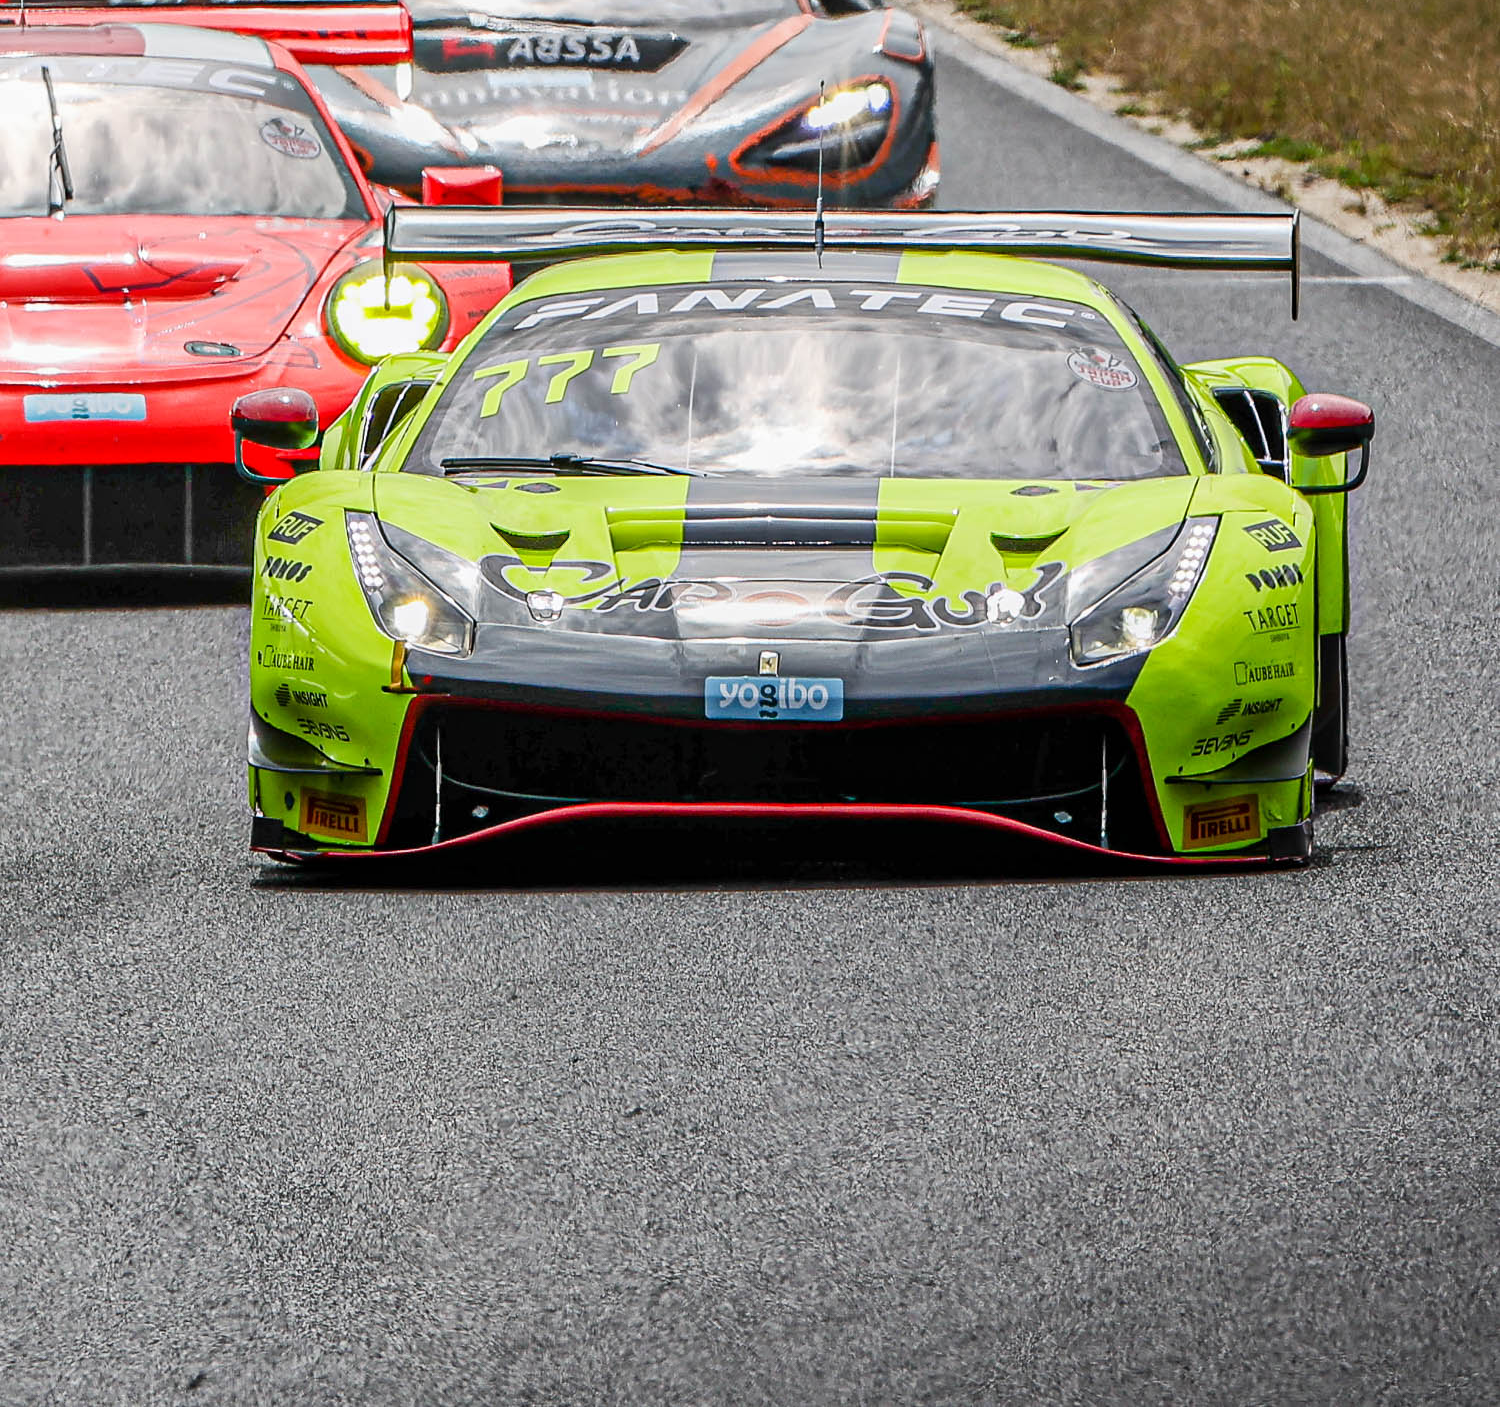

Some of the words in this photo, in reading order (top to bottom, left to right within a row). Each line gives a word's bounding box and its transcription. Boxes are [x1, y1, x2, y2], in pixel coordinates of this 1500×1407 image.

[512, 287, 1082, 330] FANATEC
[473, 342, 661, 418] 777
[272, 515, 310, 539] RUF
[1251, 528, 1292, 546] RUF
[1243, 602, 1299, 633] TARGET
[292, 689, 329, 709] INSIGHT
[718, 679, 829, 719] yogibo
[1241, 697, 1284, 717] INSIGHT
[306, 797, 361, 834] PIRELLI
[1190, 802, 1251, 841] PIRELLI
